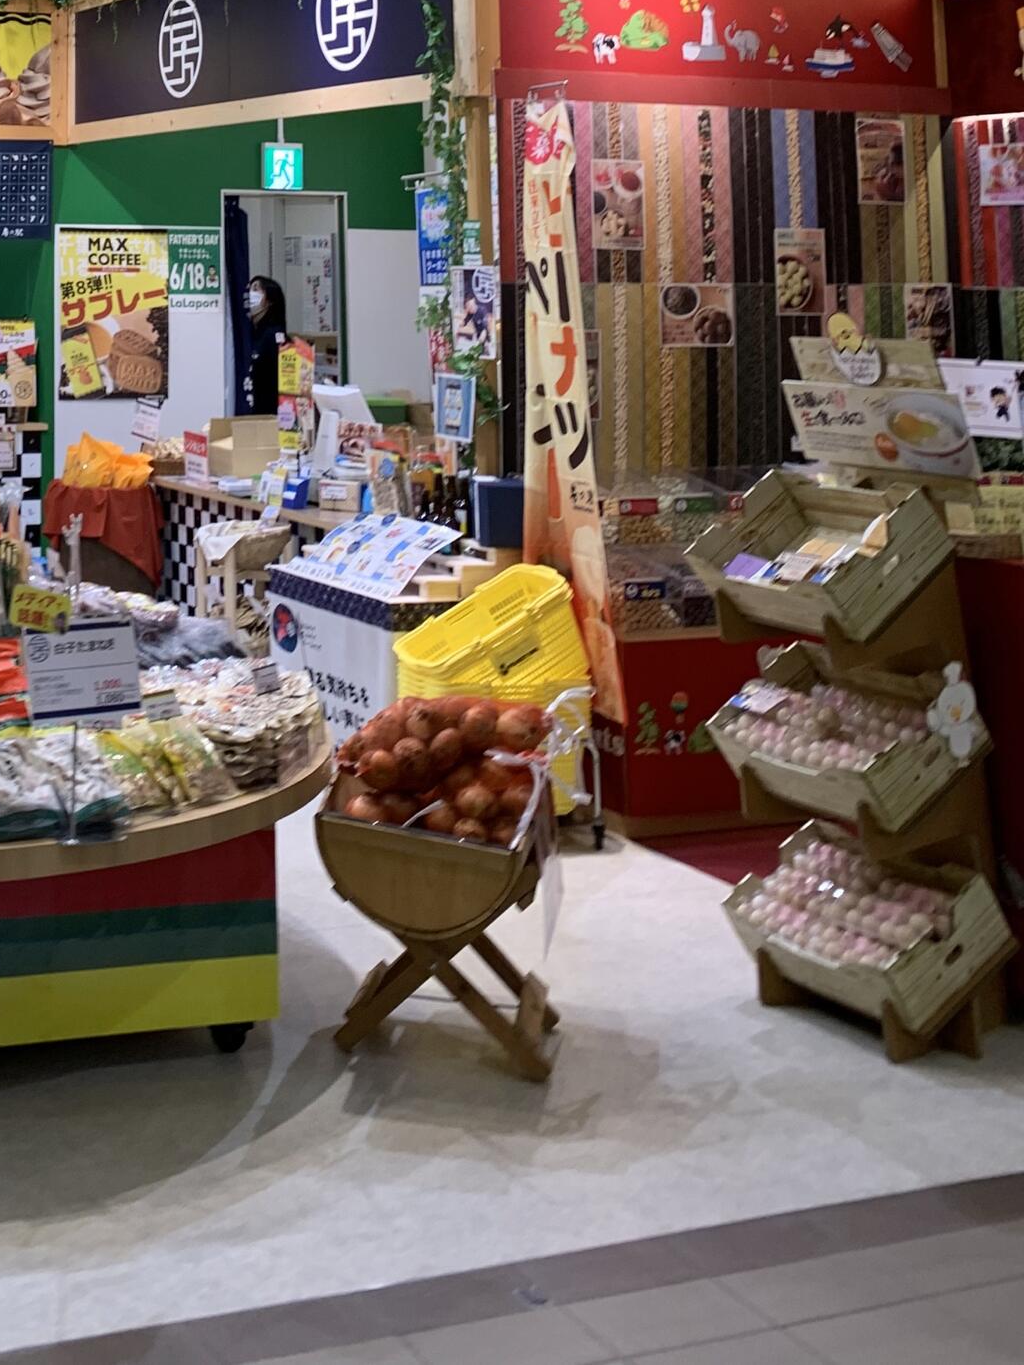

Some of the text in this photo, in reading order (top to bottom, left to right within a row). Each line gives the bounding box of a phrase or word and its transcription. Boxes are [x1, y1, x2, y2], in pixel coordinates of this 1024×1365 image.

[88, 238, 128, 251] MAX
[88, 253, 142, 266] COFFEE
[169, 263, 206, 291] 6/18
[170, 298, 219, 310] LaLaport
